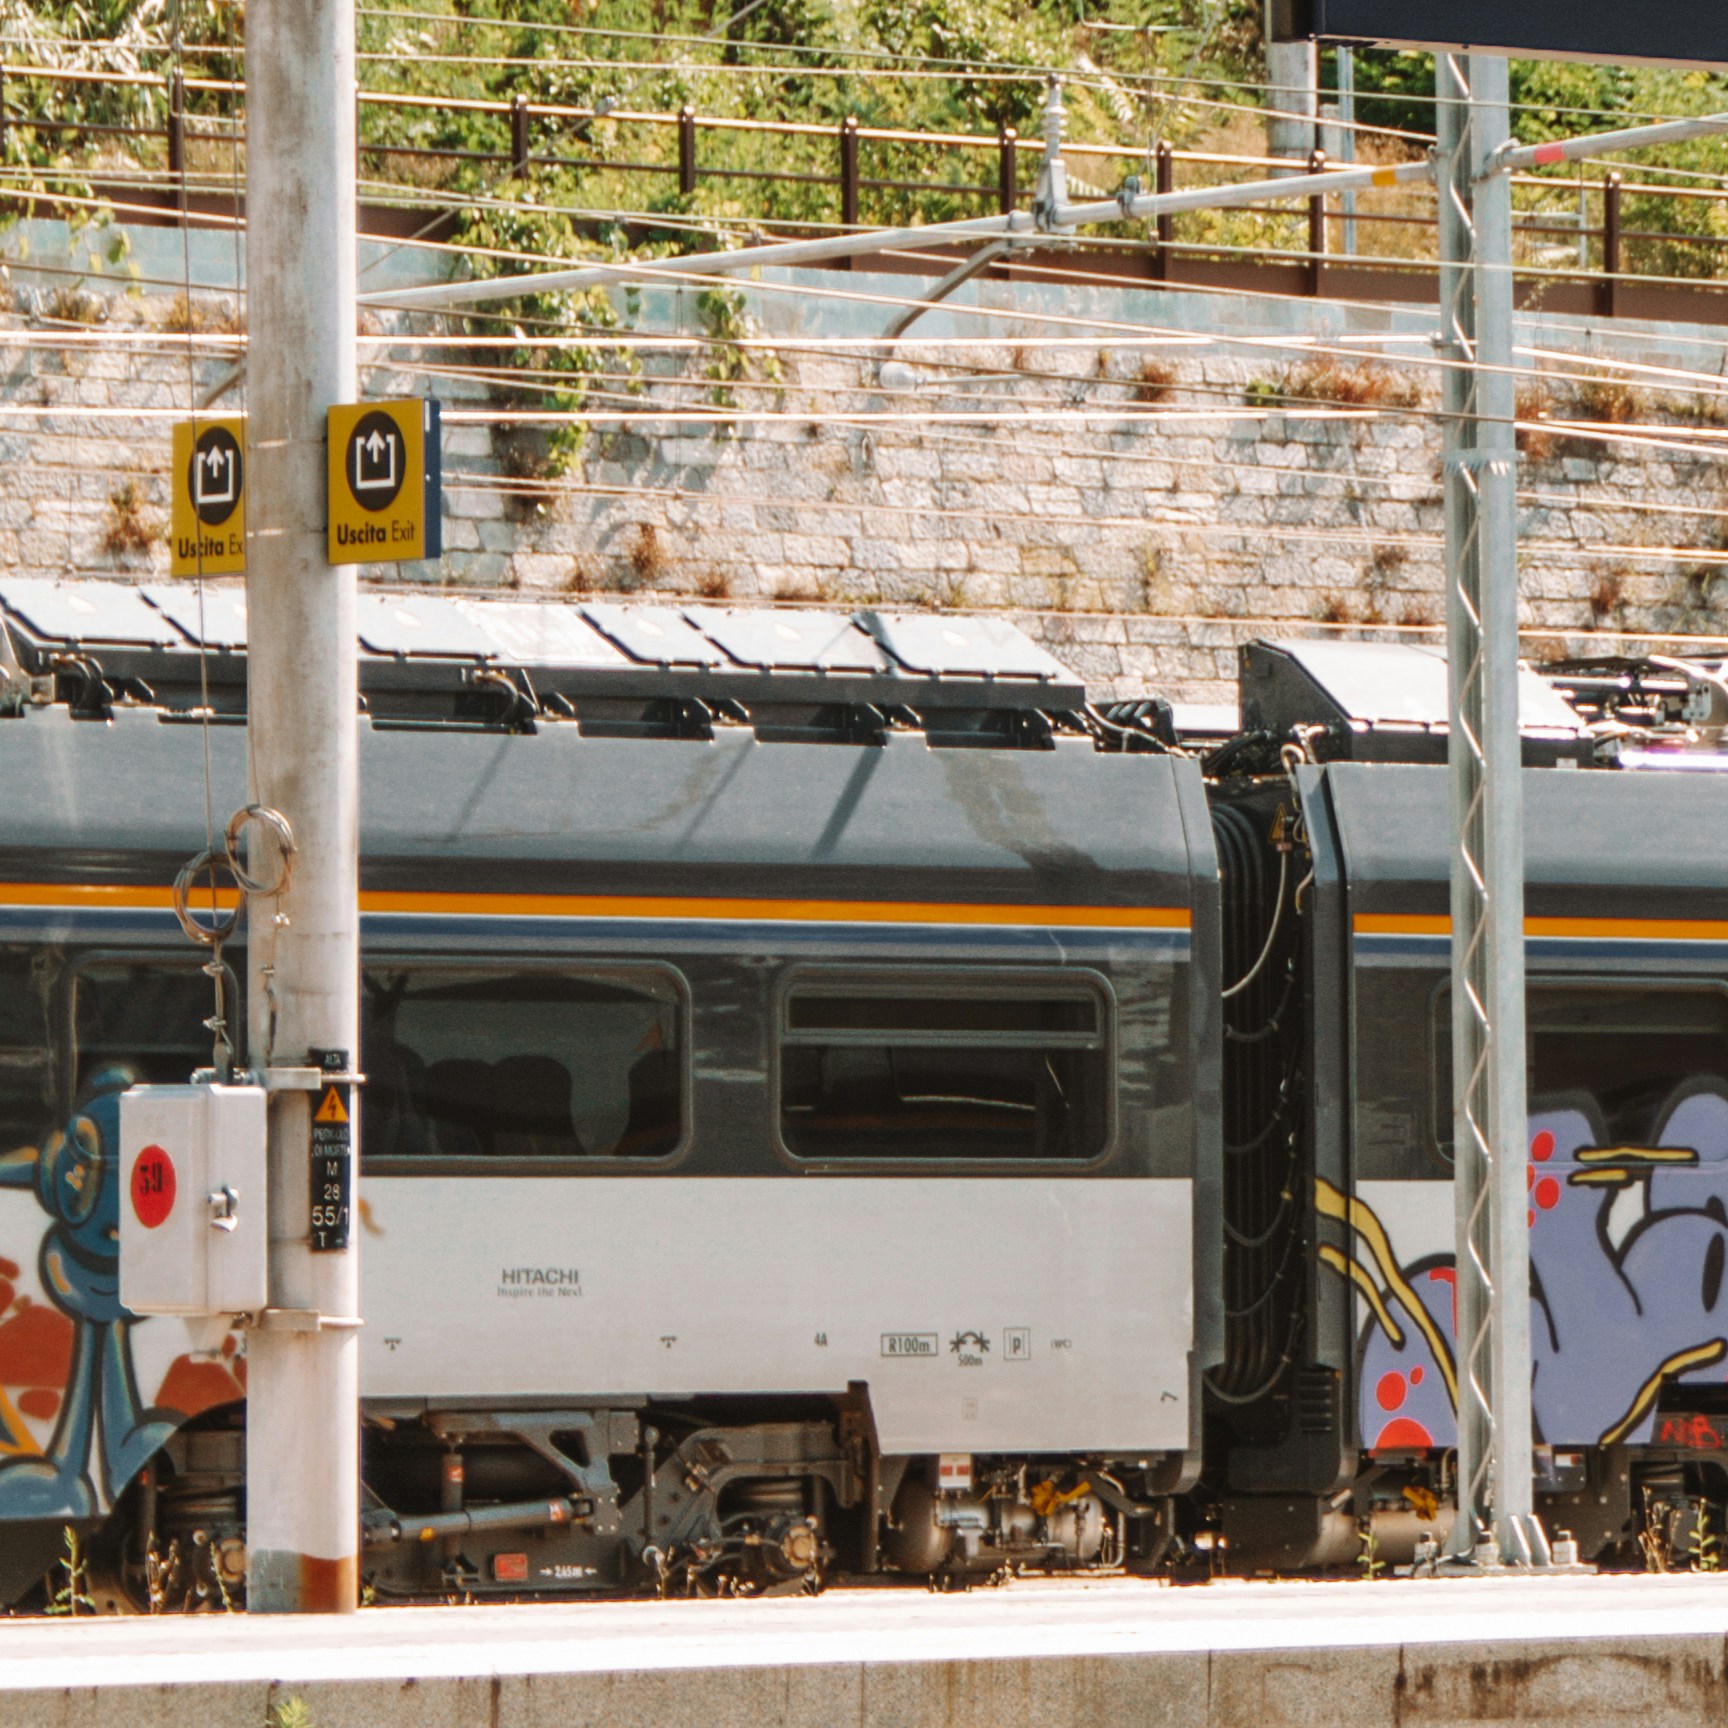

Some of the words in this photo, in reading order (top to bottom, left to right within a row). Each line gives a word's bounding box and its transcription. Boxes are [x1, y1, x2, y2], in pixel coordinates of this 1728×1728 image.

[337, 524, 386, 546] Uscita
[391, 519, 416, 543] Exit
[323, 1183, 341, 1201] 28
[501, 1267, 579, 1286] HITACHI
[888, 1337, 930, 1353] R100m
